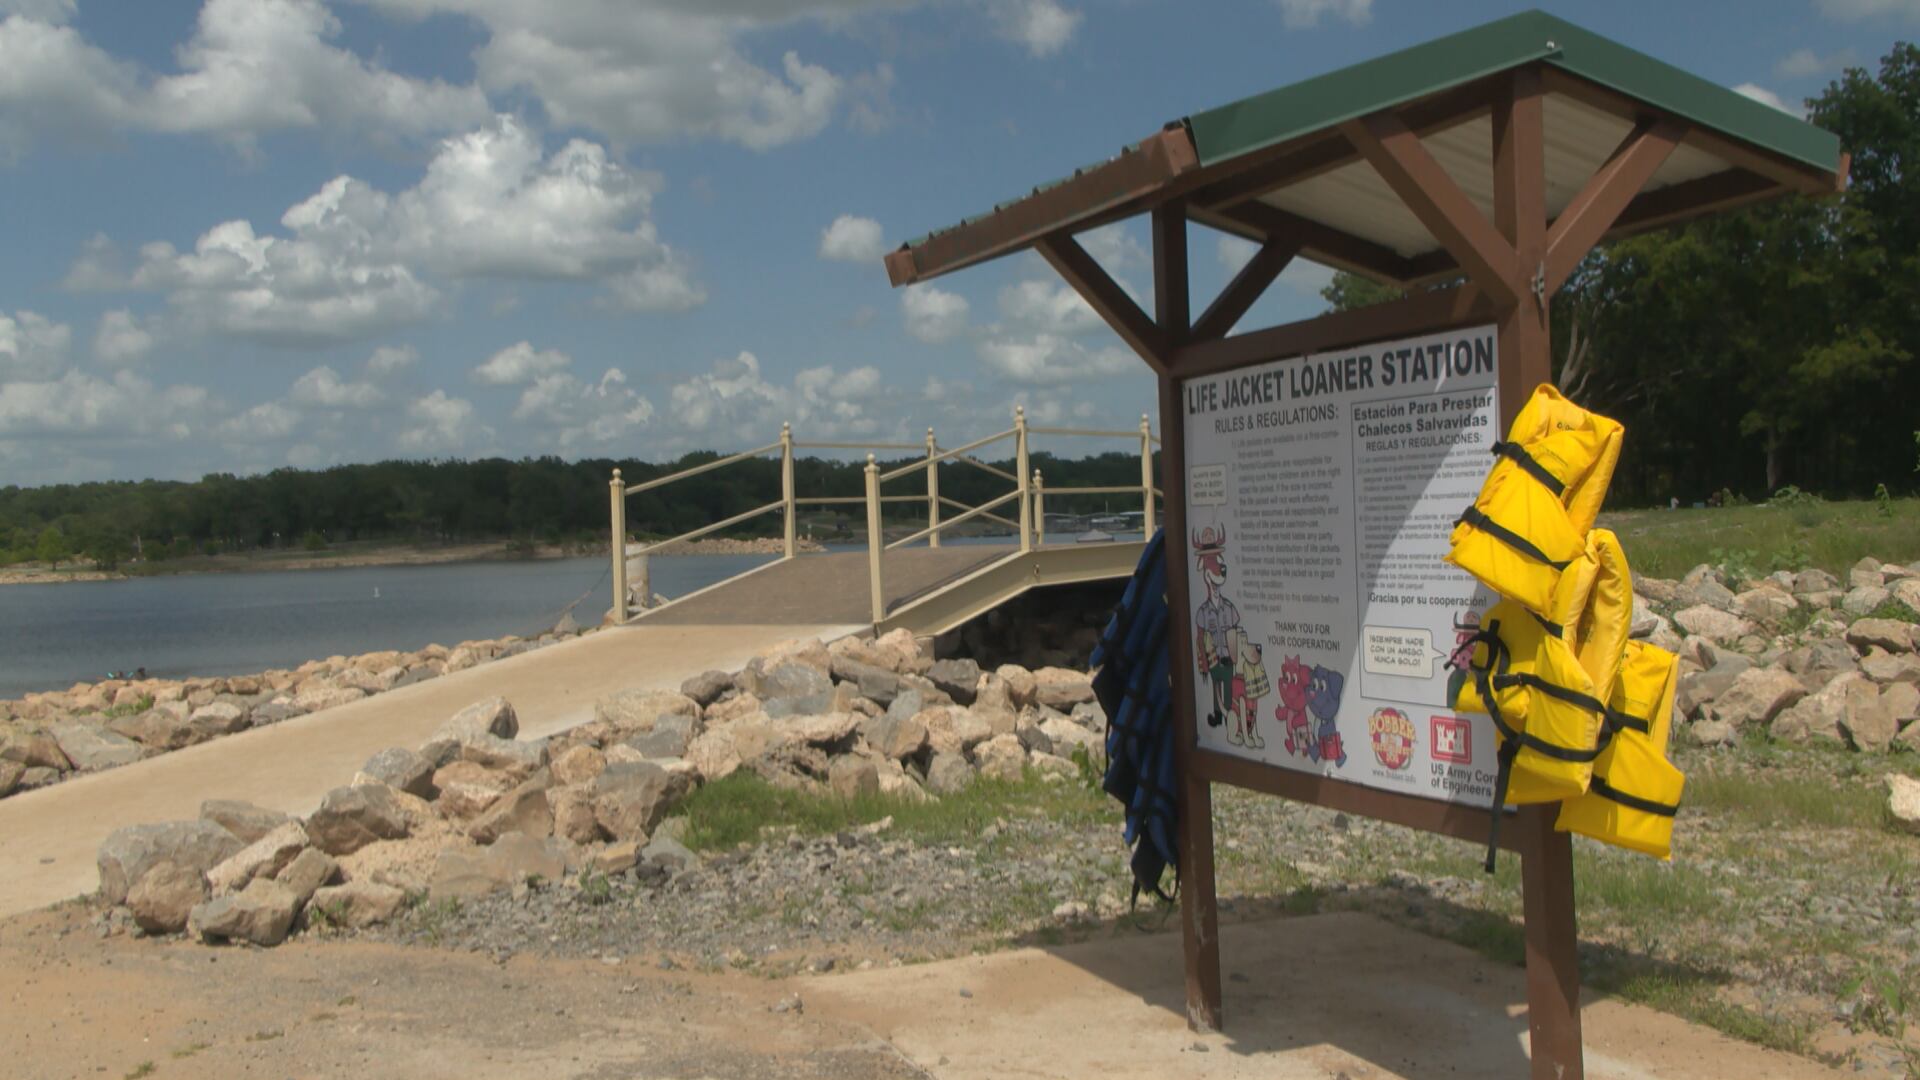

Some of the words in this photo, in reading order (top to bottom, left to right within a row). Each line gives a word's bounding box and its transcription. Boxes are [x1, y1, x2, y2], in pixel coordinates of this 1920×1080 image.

[1188, 382, 1218, 415] LIFE
[1221, 369, 1284, 410] JACKET
[1290, 355, 1374, 399] LOANER
[1381, 336, 1493, 386] STATION
[1354, 404, 1405, 421] Estación
[1408, 401, 1438, 415] Para
[1442, 395, 1492, 411] Prestar
[1215, 414, 1245, 434] RULES
[1247, 415, 1254, 430] &
[1256, 402, 1340, 429] REGULATIONS:
[1358, 422, 1412, 438] Chalecos
[1416, 413, 1488, 432] Salvavidas
[1366, 439, 1399, 452] REGLAS
[1400, 439, 1406, 449] Y
[1408, 432, 1483, 449] REGULACIONES:
[1401, 595, 1415, 607] por
[1429, 595, 1487, 608] cooperación!
[1275, 621, 1297, 632] THANK
[1299, 623, 1313, 634] YOU
[1315, 624, 1330, 635] FOR
[1267, 634, 1285, 646] YOUR
[1287, 636, 1340, 651] COOPERATION!
[1370, 645, 1384, 653] CON
[1431, 762, 1444, 775] US
[1447, 766, 1471, 781] Army
[1431, 777, 1440, 786] of
[1443, 779, 1491, 796] Engineers
